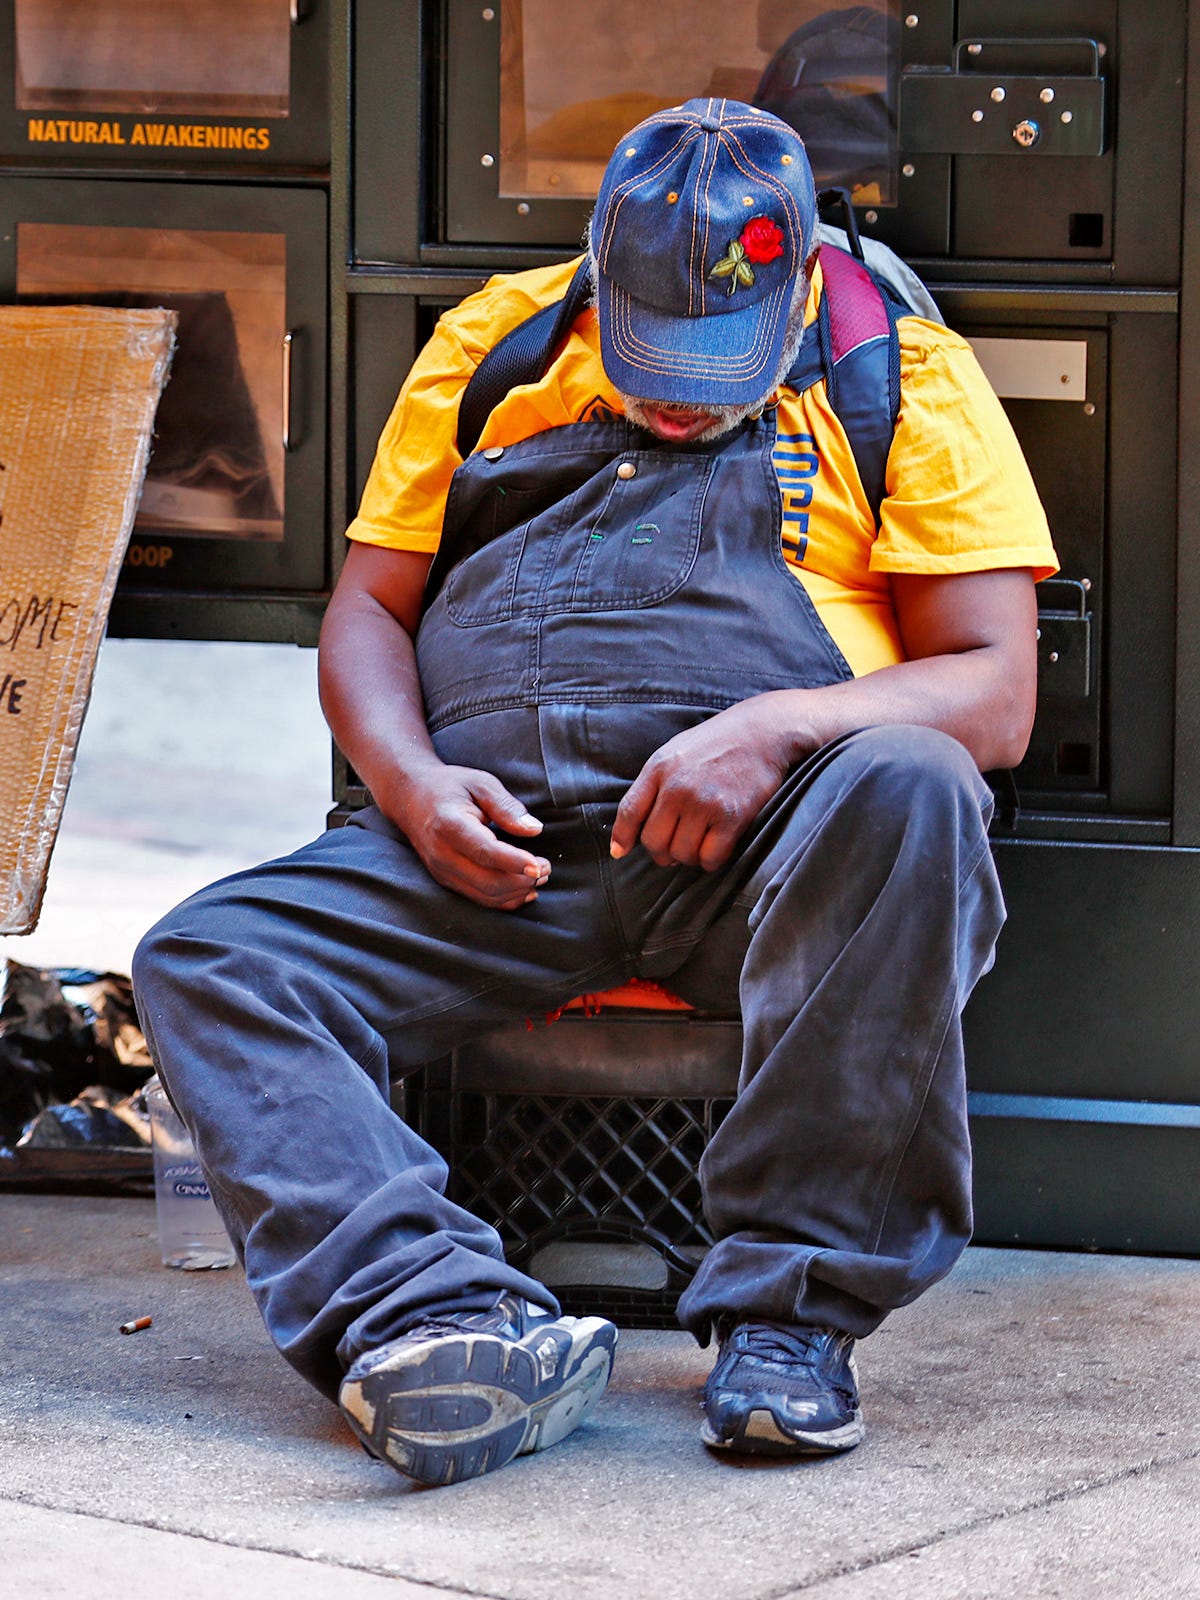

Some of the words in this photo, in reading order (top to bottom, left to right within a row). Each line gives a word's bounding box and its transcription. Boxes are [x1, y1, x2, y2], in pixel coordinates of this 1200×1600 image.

[28, 119, 126, 144] NATURAL
[130, 123, 270, 150] AWAKENINGS
[124, 545, 174, 567] OOP
